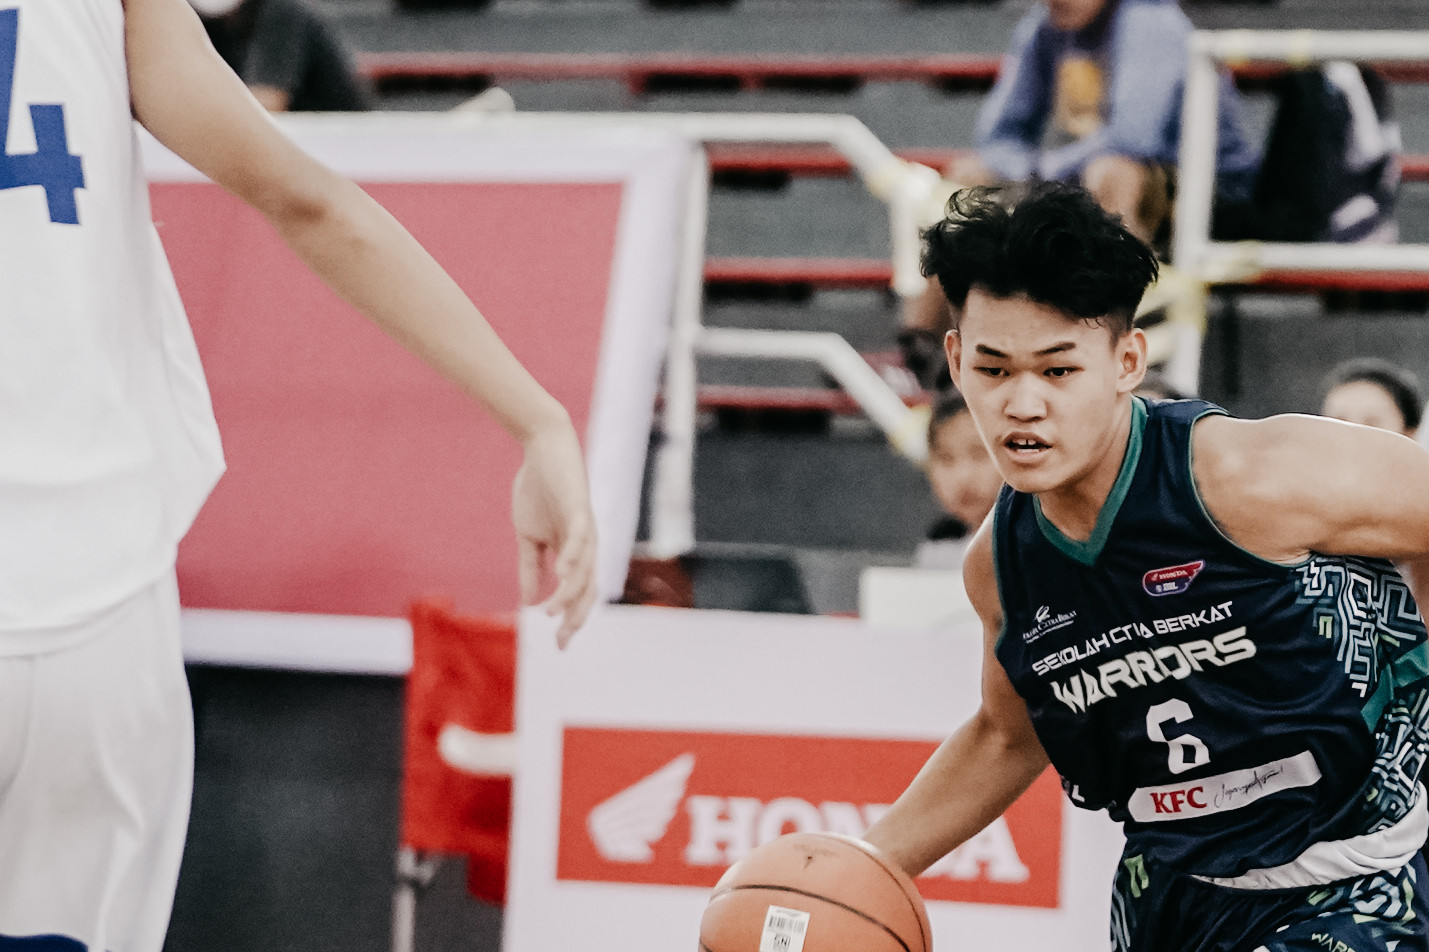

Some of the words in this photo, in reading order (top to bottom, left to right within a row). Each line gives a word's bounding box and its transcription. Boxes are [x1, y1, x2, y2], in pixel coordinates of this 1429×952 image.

[0, 8, 86, 225] 4
[1031, 633, 1111, 677] SEKOLAH
[1153, 600, 1233, 635] BERKAT
[1145, 697, 1211, 775] 6
[1150, 786, 1207, 815] KFC
